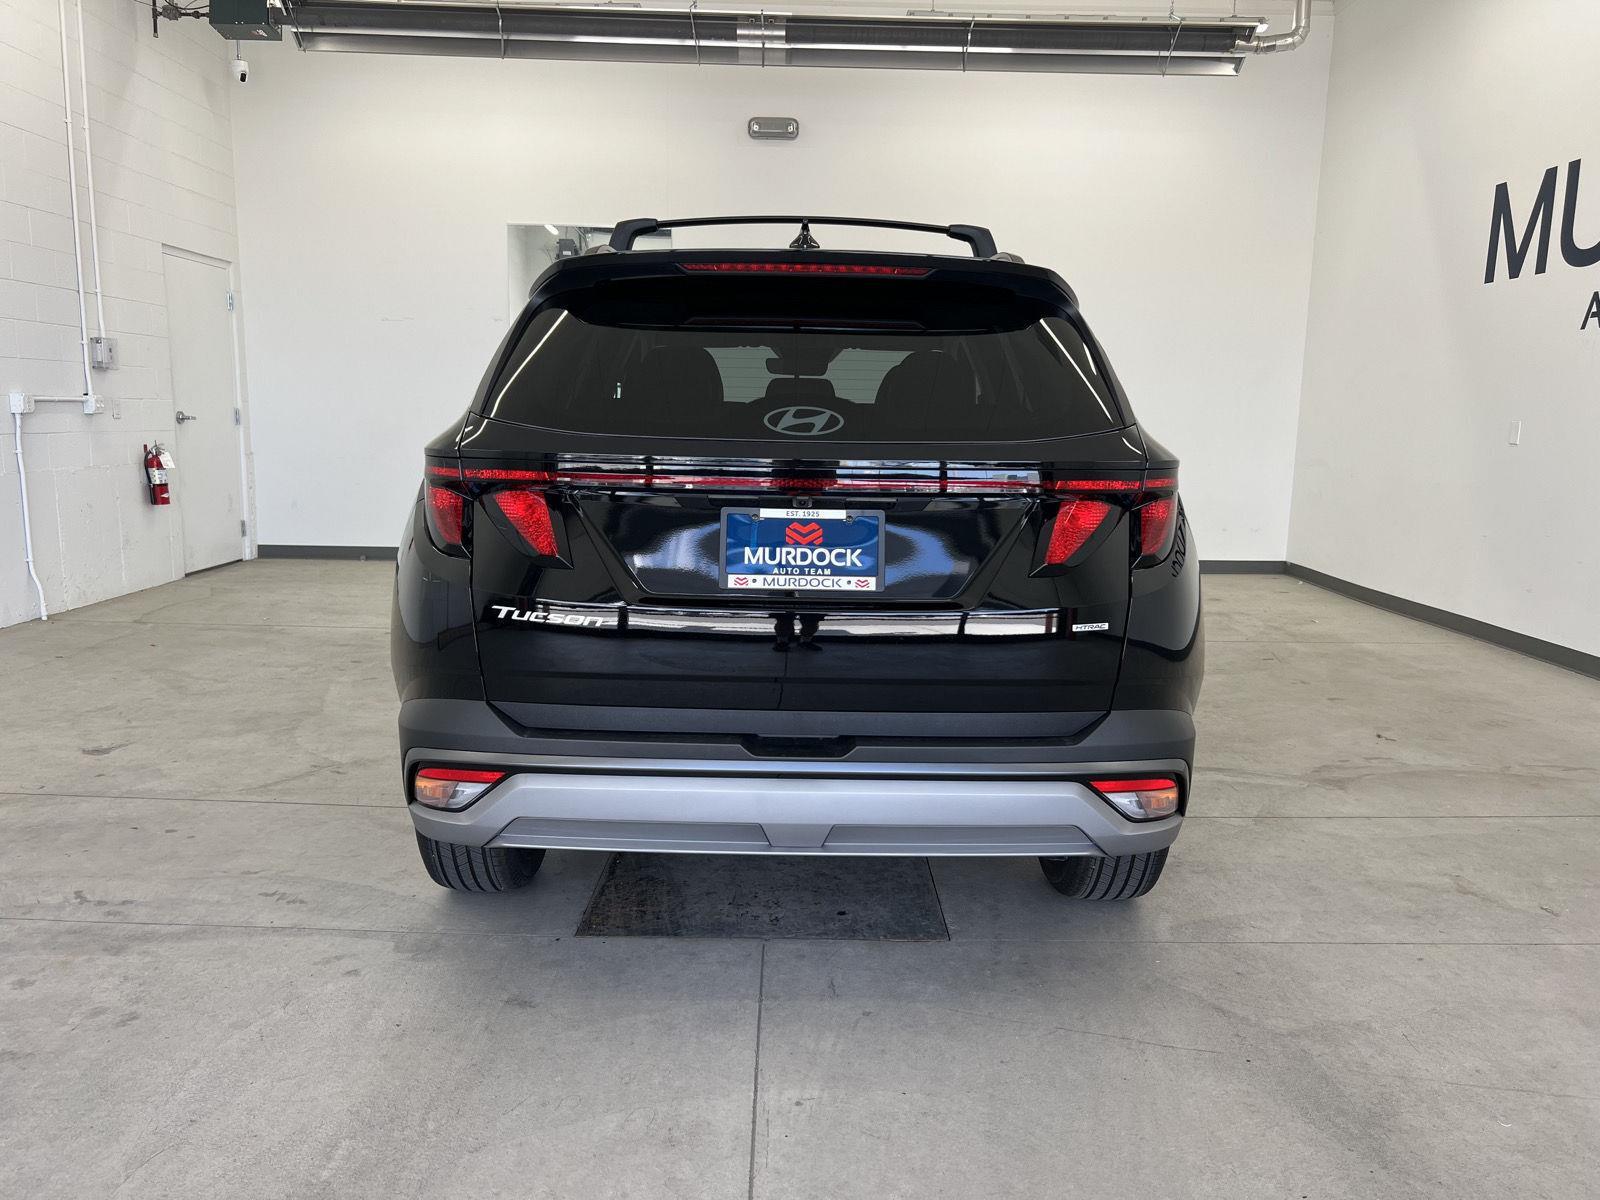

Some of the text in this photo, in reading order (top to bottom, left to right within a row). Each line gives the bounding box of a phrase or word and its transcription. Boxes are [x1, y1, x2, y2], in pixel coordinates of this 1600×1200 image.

[802, 510, 820, 518] 1925
[744, 546, 862, 567] MURDOCK
[772, 567, 831, 575] AUTO TEAM
[762, 577, 842, 588] MURDOCK
